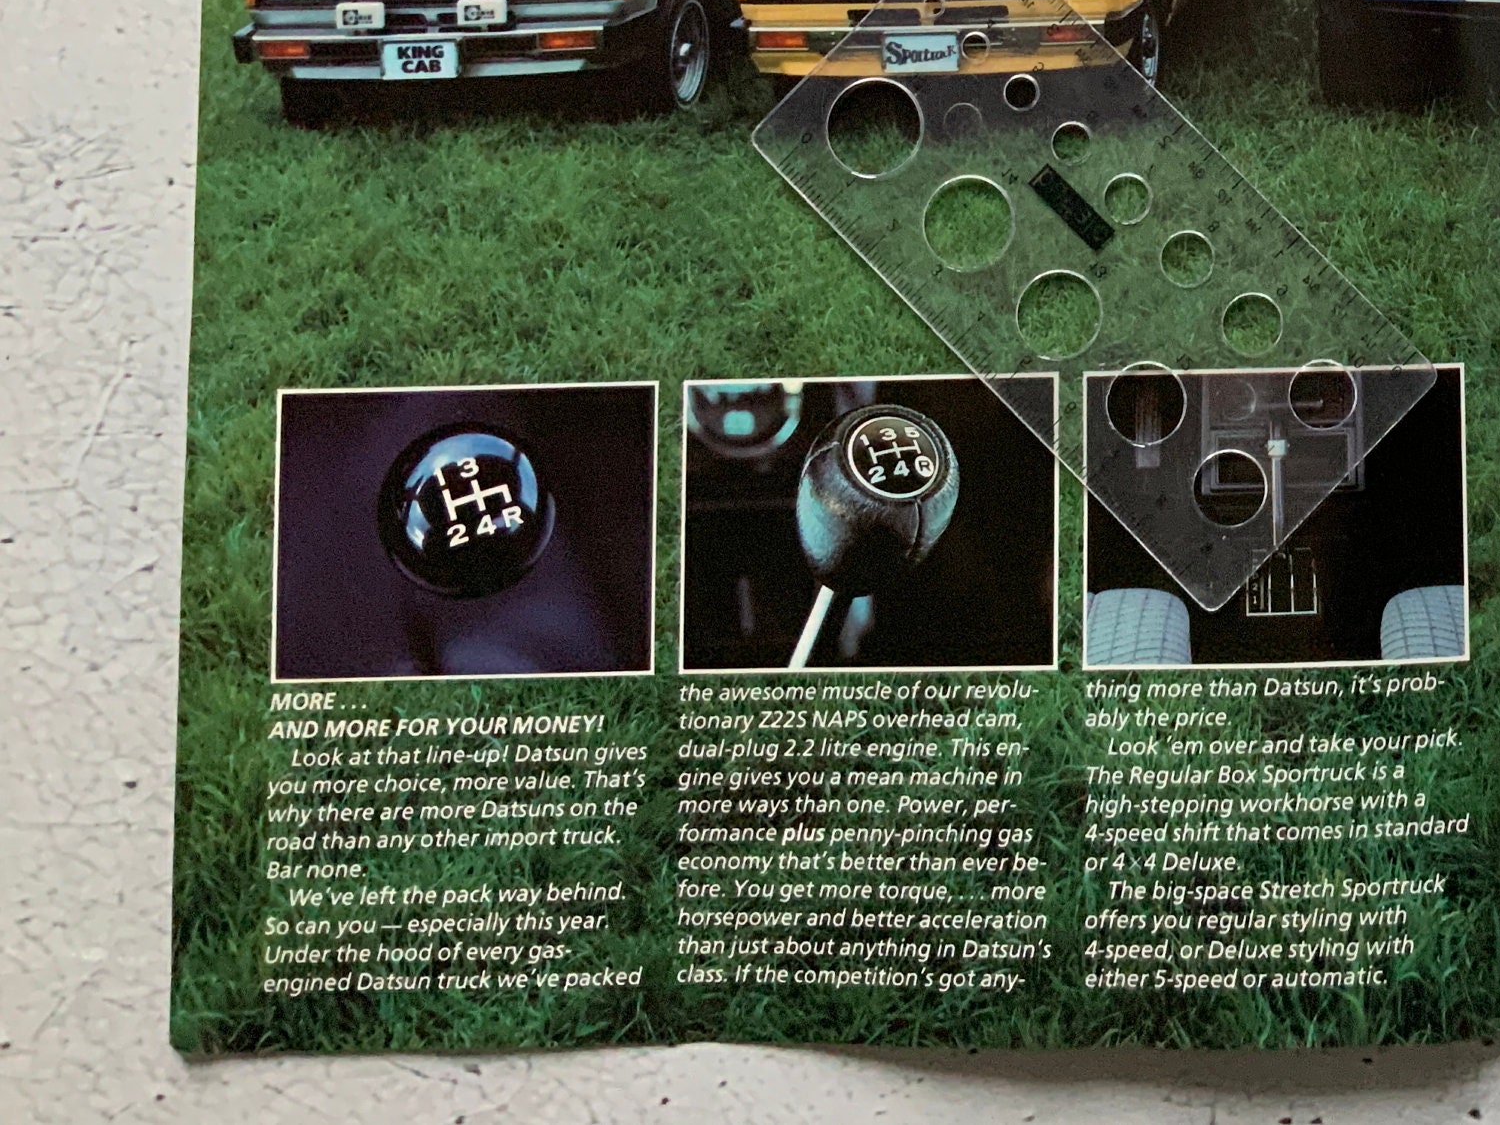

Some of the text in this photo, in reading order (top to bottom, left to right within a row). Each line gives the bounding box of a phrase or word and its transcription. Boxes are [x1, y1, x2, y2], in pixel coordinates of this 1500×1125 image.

[397, 45, 444, 59] KING
[402, 60, 442, 73] CAB
[860, 426, 920, 446] 1 3 5
[433, 457, 480, 486] 1 3
[868, 465, 887, 484] 2
[893, 459, 911, 477] 4
[446, 505, 525, 548] 2 4 R
[679, 679, 1039, 702] the awesome muscle of our revolu-
[267, 714, 605, 740] AND MORE FOR YOUR MONEY!
[679, 708, 1023, 734] tionary Z22S NAPS overhead cam,
[1107, 735, 1160, 756] Look
[1209, 739, 1258, 755] over
[1261, 733, 1305, 754] and
[1309, 732, 1356, 753] take
[1359, 735, 1411, 757] your
[1414, 726, 1463, 754] pick.
[291, 742, 648, 768] Look at that line-up! Datsun gives
[1085, 788, 1426, 819] high-stepping workhorse with a
[678, 822, 1033, 848] formance plus penny-pinching gas
[289, 881, 626, 908] We've left the pack way behind.
[1109, 873, 1446, 906] The big-space Stretch Sportruck
[677, 907, 1047, 931] horsepower and better acceleration
[678, 934, 1052, 963] than just about anything in Datsun's
[263, 965, 643, 997] engined Datsun truck we've packed
[1085, 967, 1387, 994] either 5-speed or automatic.
